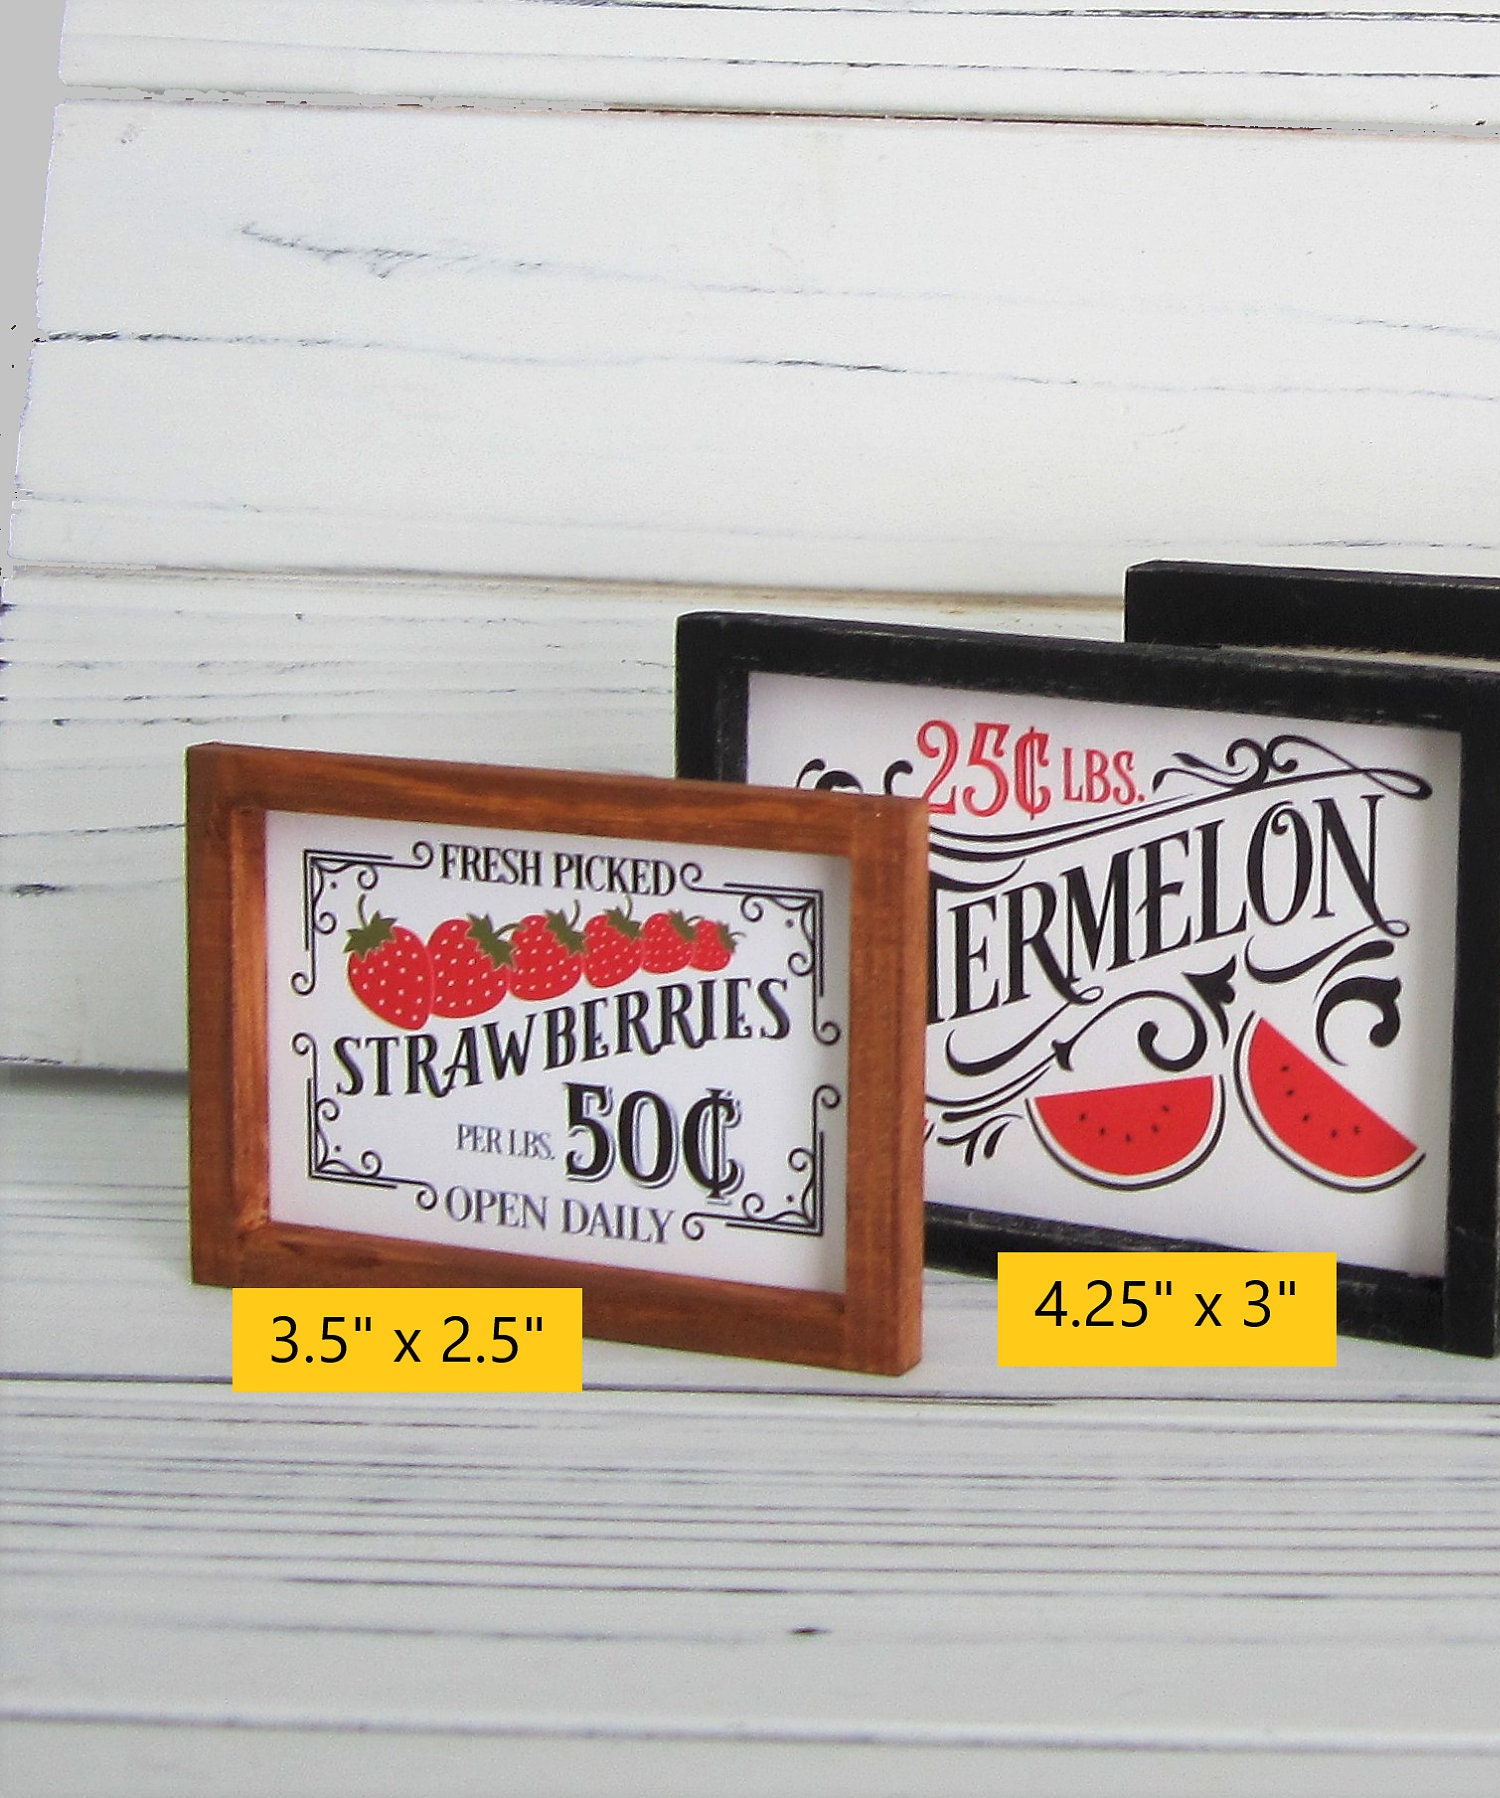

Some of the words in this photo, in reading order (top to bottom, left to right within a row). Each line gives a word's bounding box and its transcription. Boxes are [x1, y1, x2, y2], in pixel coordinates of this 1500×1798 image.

[1063, 749, 1146, 803] LBS.
[439, 844, 542, 888] FRESH
[553, 854, 677, 897] PICKED
[333, 977, 791, 1099] STRAWBERRIES
[457, 1124, 501, 1155] PER
[507, 1127, 556, 1162] LBS.
[445, 1185, 547, 1231] OPEN
[561, 1198, 675, 1245] DAILY
